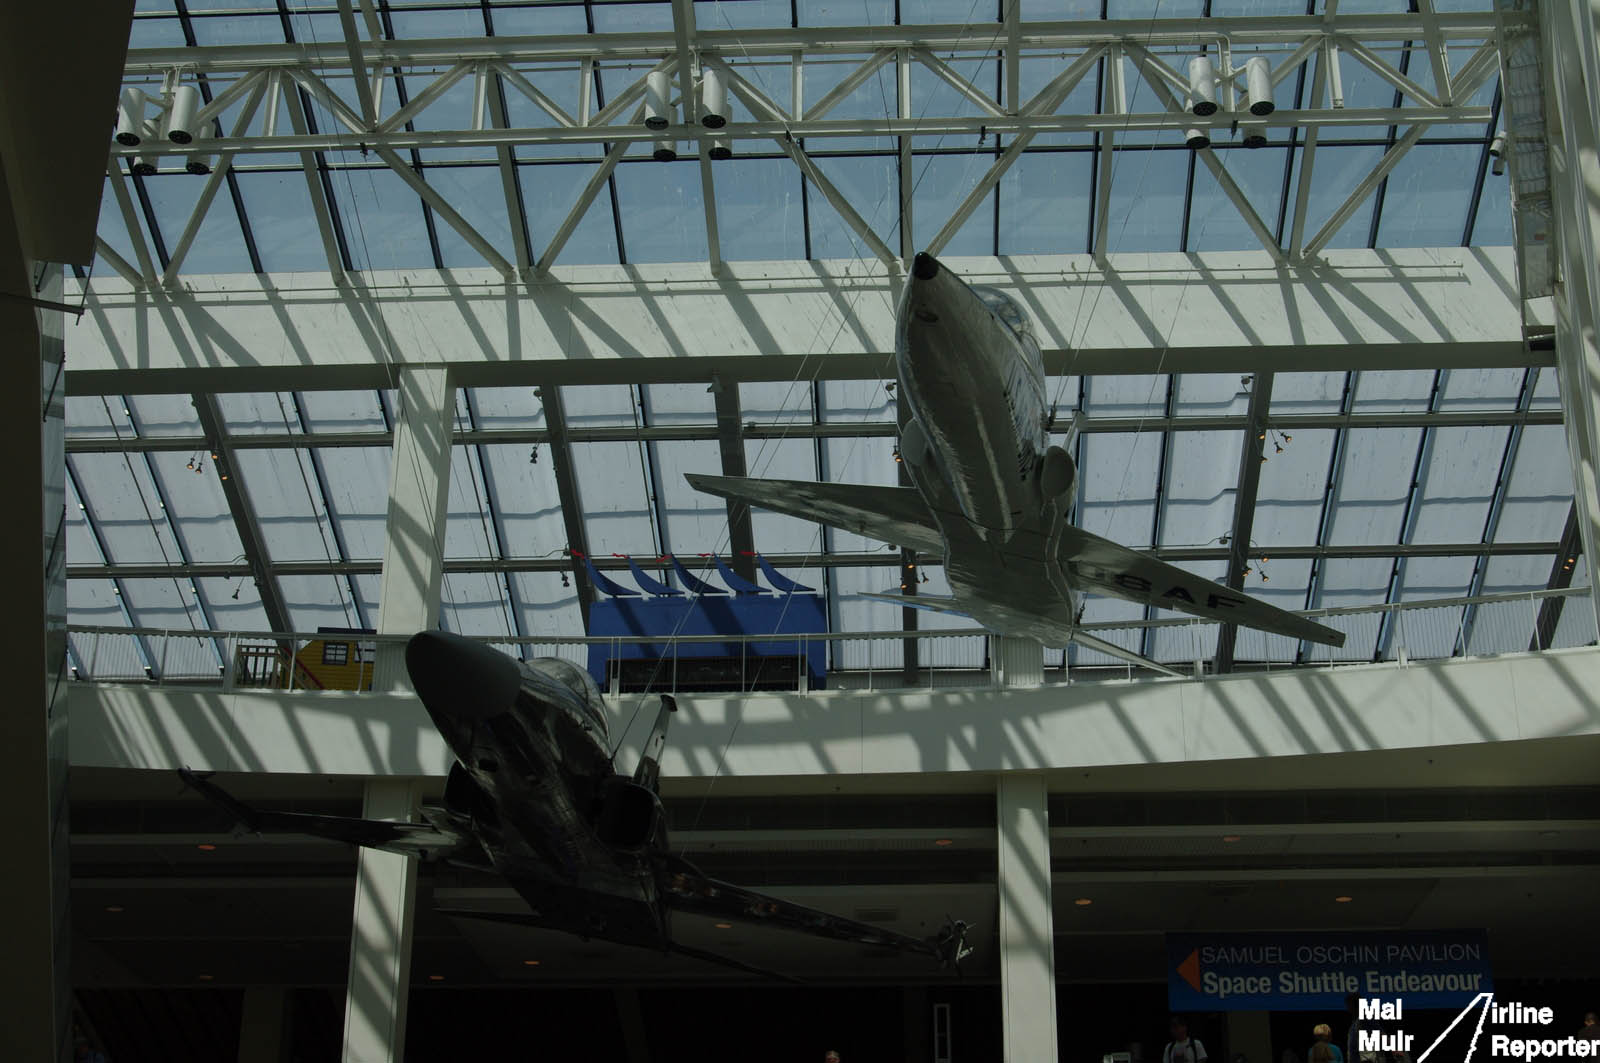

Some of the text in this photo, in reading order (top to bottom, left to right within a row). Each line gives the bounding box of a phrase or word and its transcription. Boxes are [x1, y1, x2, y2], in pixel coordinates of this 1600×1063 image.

[1076, 563, 1245, 608] SAF
[1201, 944, 1480, 964] SAMUEL OSCHIN PAVILION
[1203, 970, 1482, 999] Space Shuttle Endeavour
